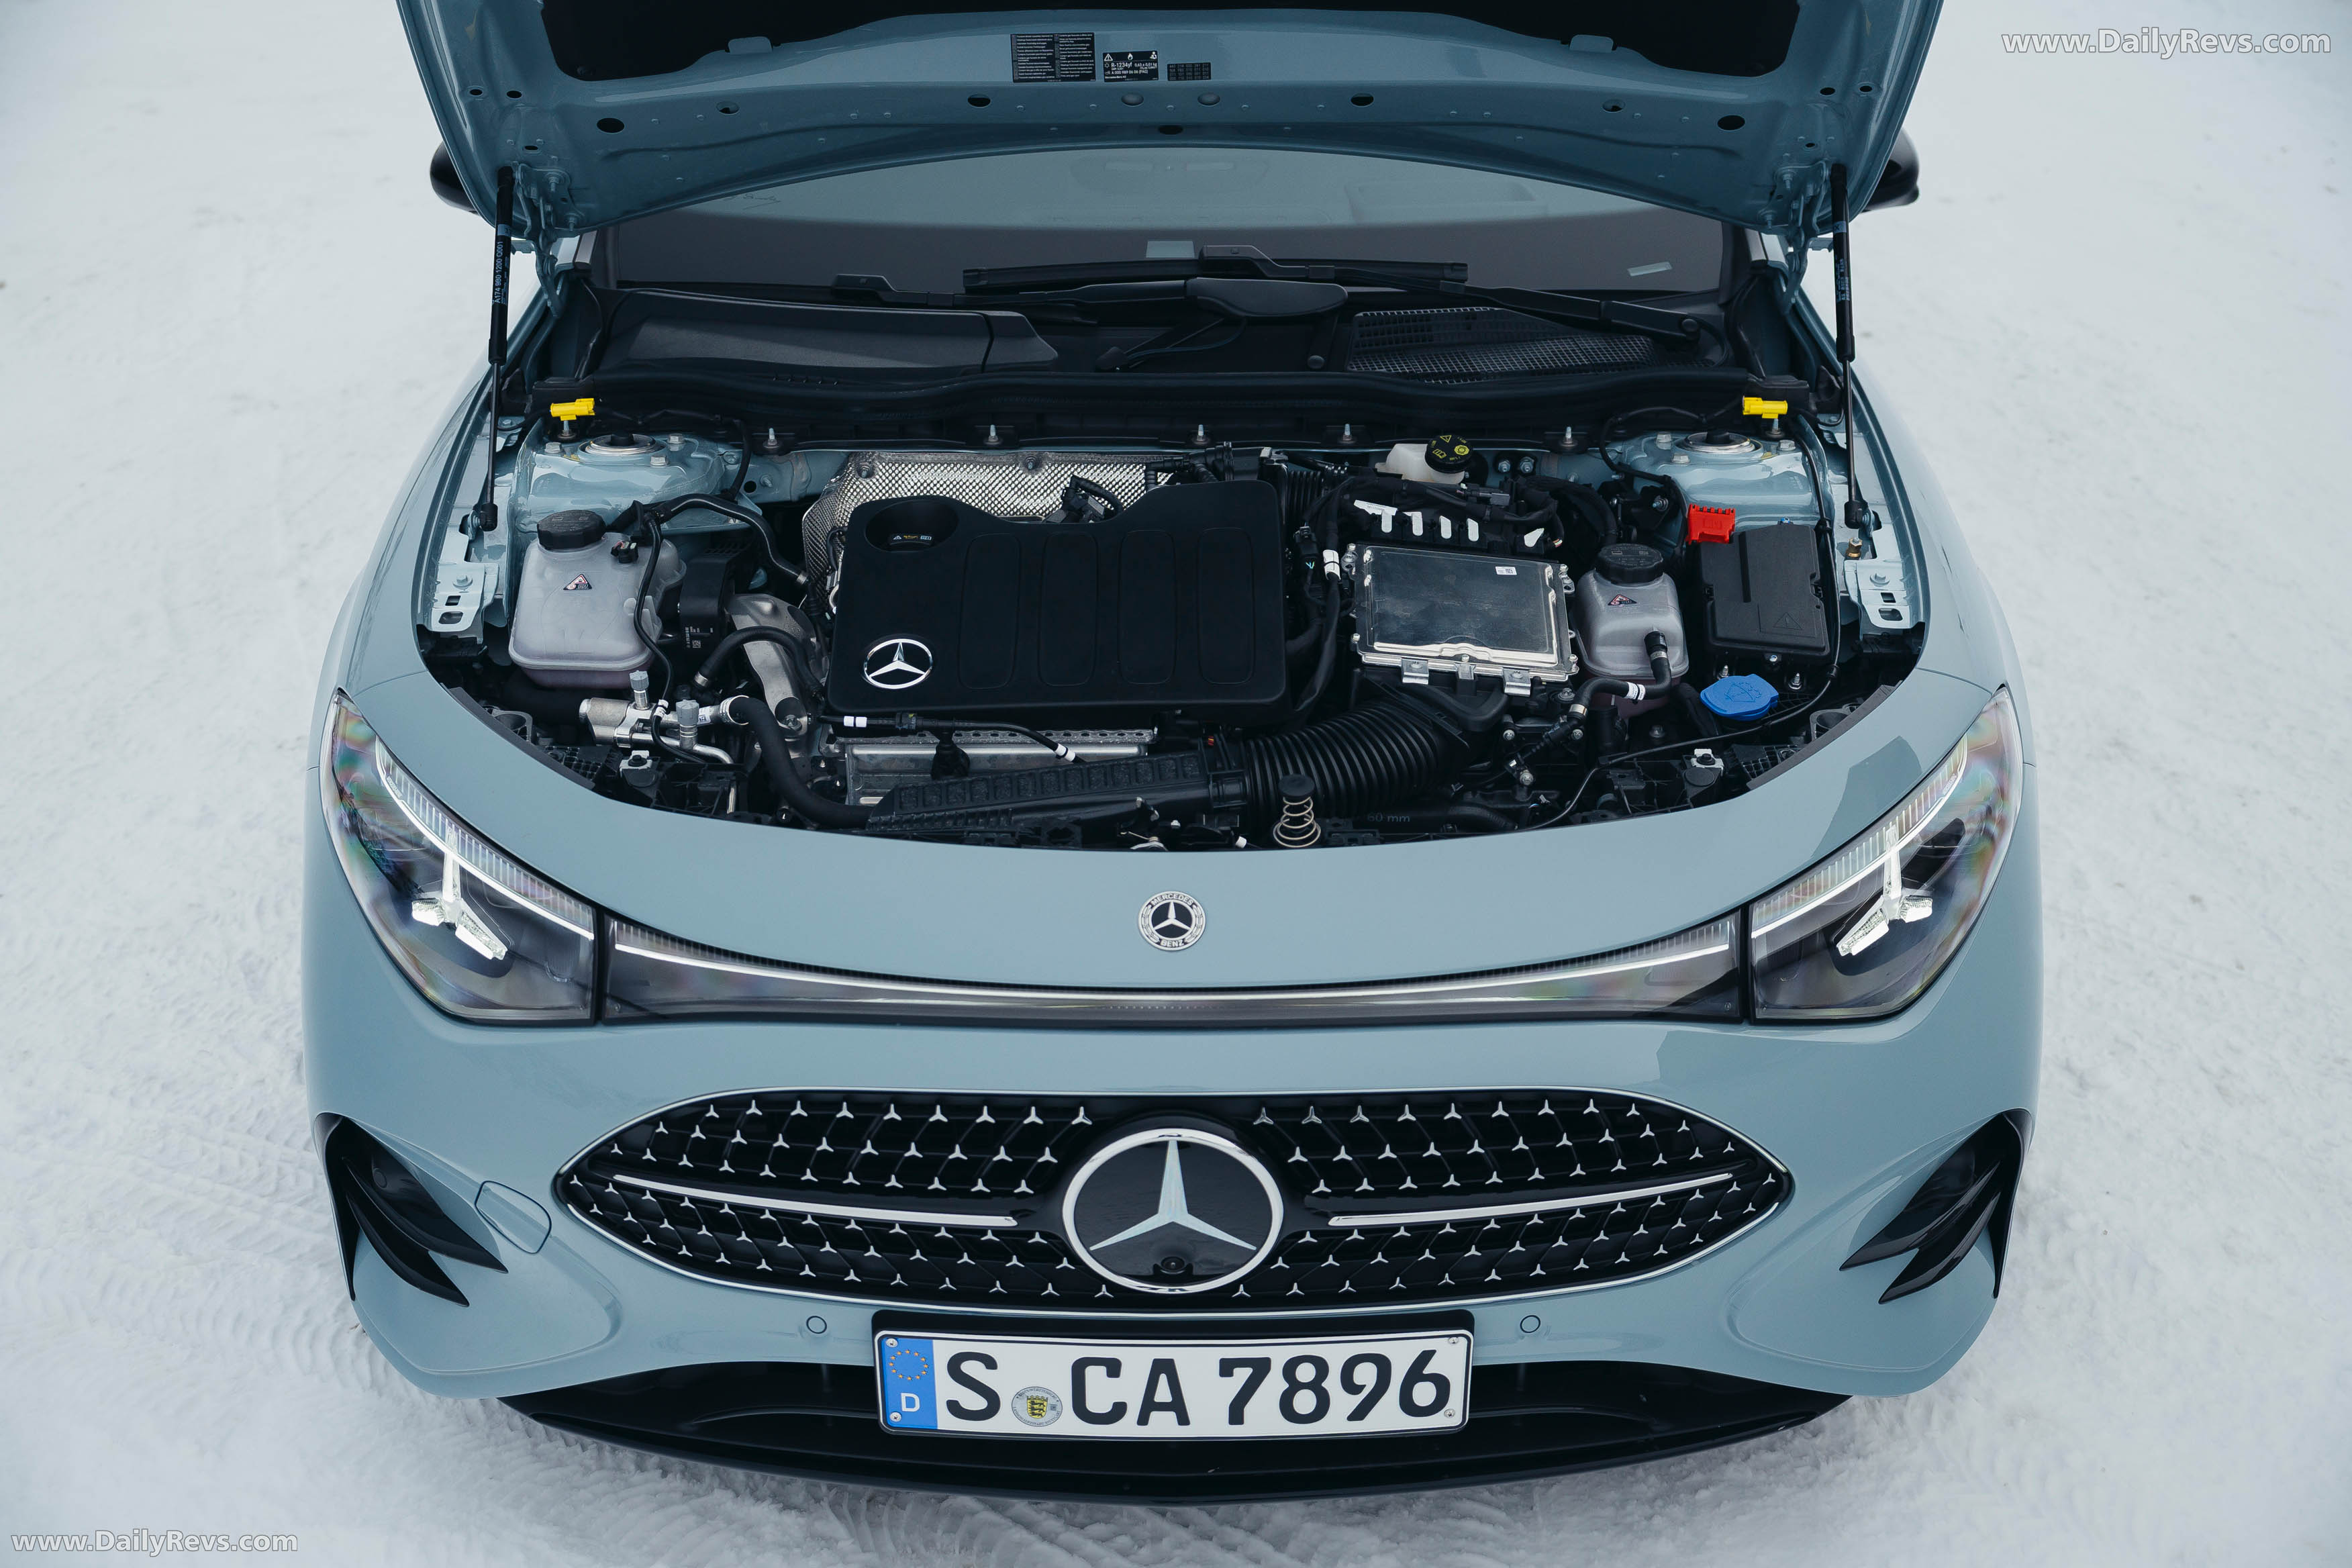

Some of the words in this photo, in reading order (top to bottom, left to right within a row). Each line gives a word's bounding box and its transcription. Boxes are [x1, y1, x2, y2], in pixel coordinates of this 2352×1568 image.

[1150, 893, 1194, 906] MERCEDES
[946, 1351, 1001, 1421] S
[1071, 1357, 1190, 1426] CA
[1218, 1349, 1451, 1426] 7896
[901, 1392, 920, 1412] D
